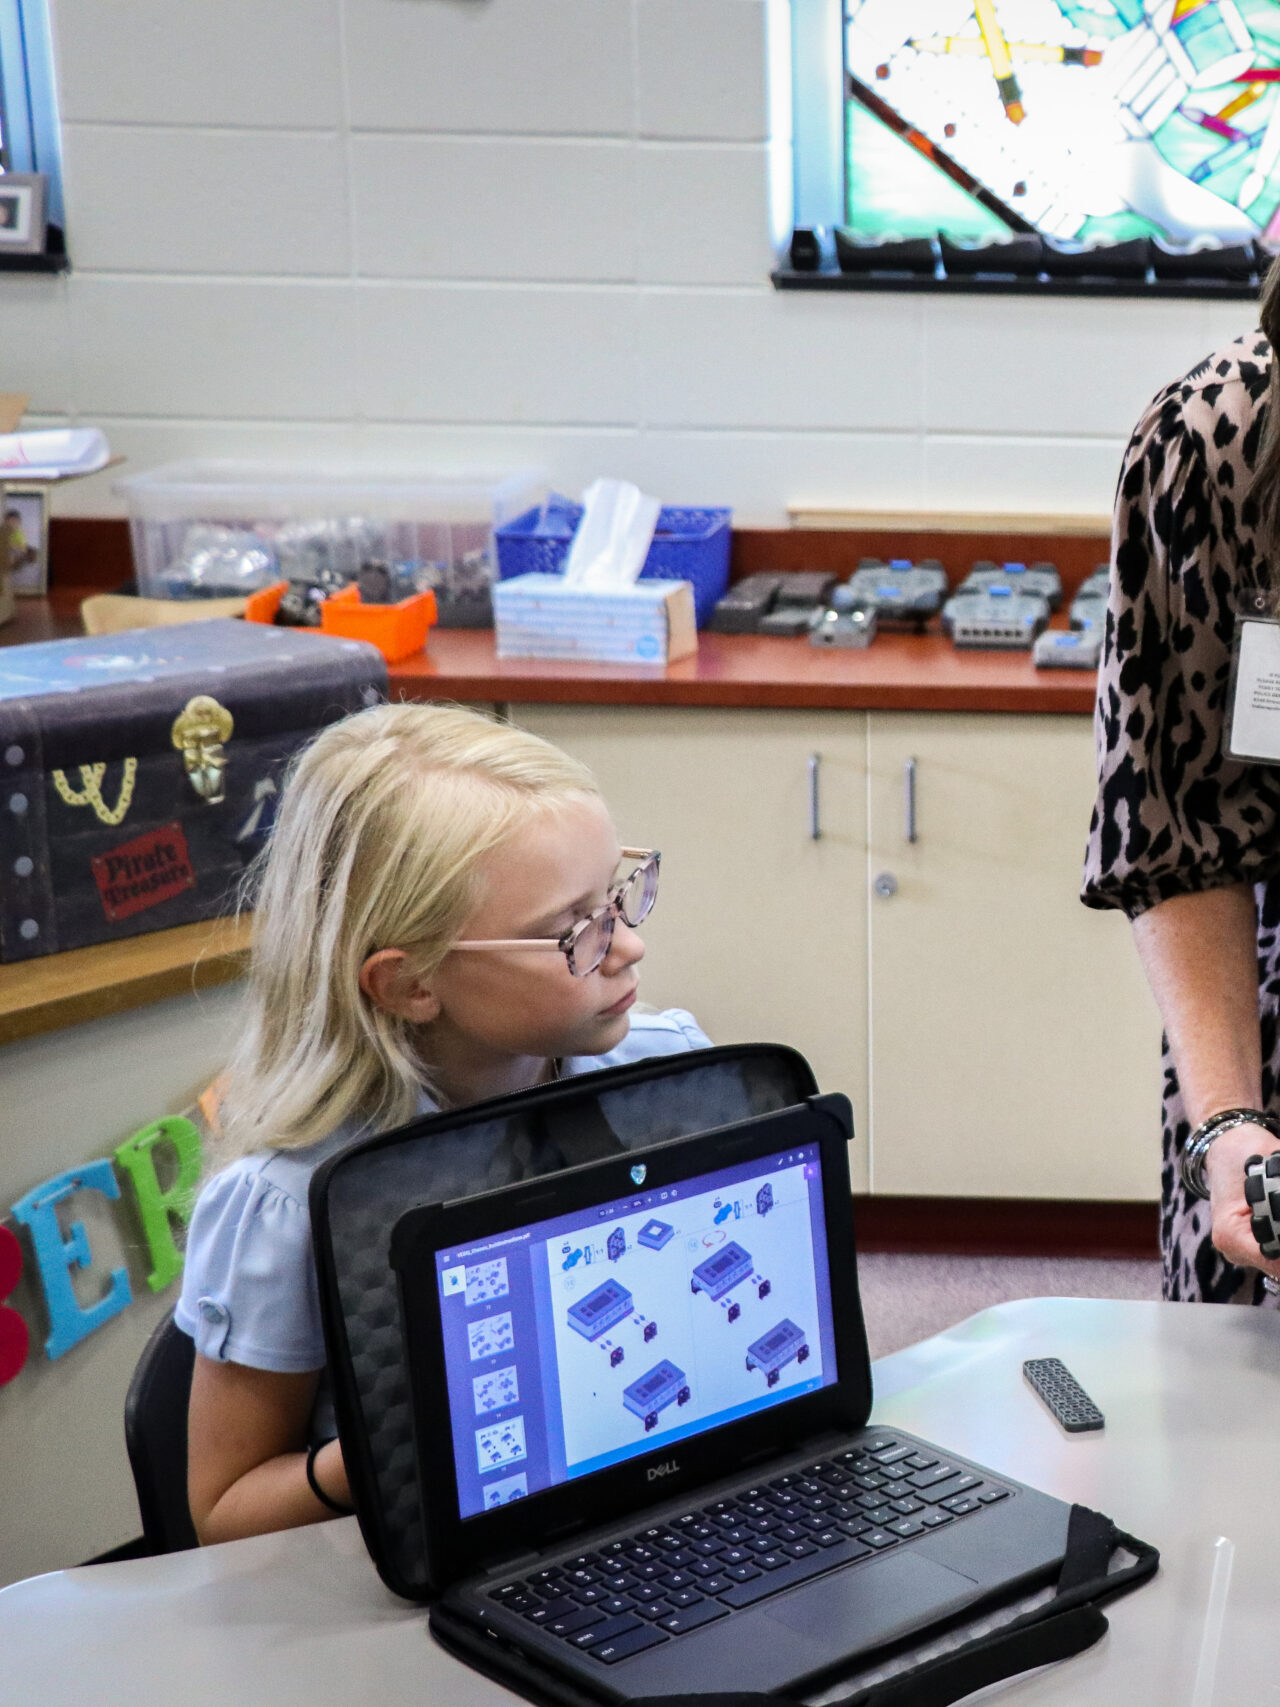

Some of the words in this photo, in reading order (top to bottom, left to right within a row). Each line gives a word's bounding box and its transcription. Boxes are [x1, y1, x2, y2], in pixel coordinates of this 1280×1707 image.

[104, 843, 178, 882] Pirate
[103, 864, 189, 906] Treasure
[647, 1460, 680, 1481] DELL
